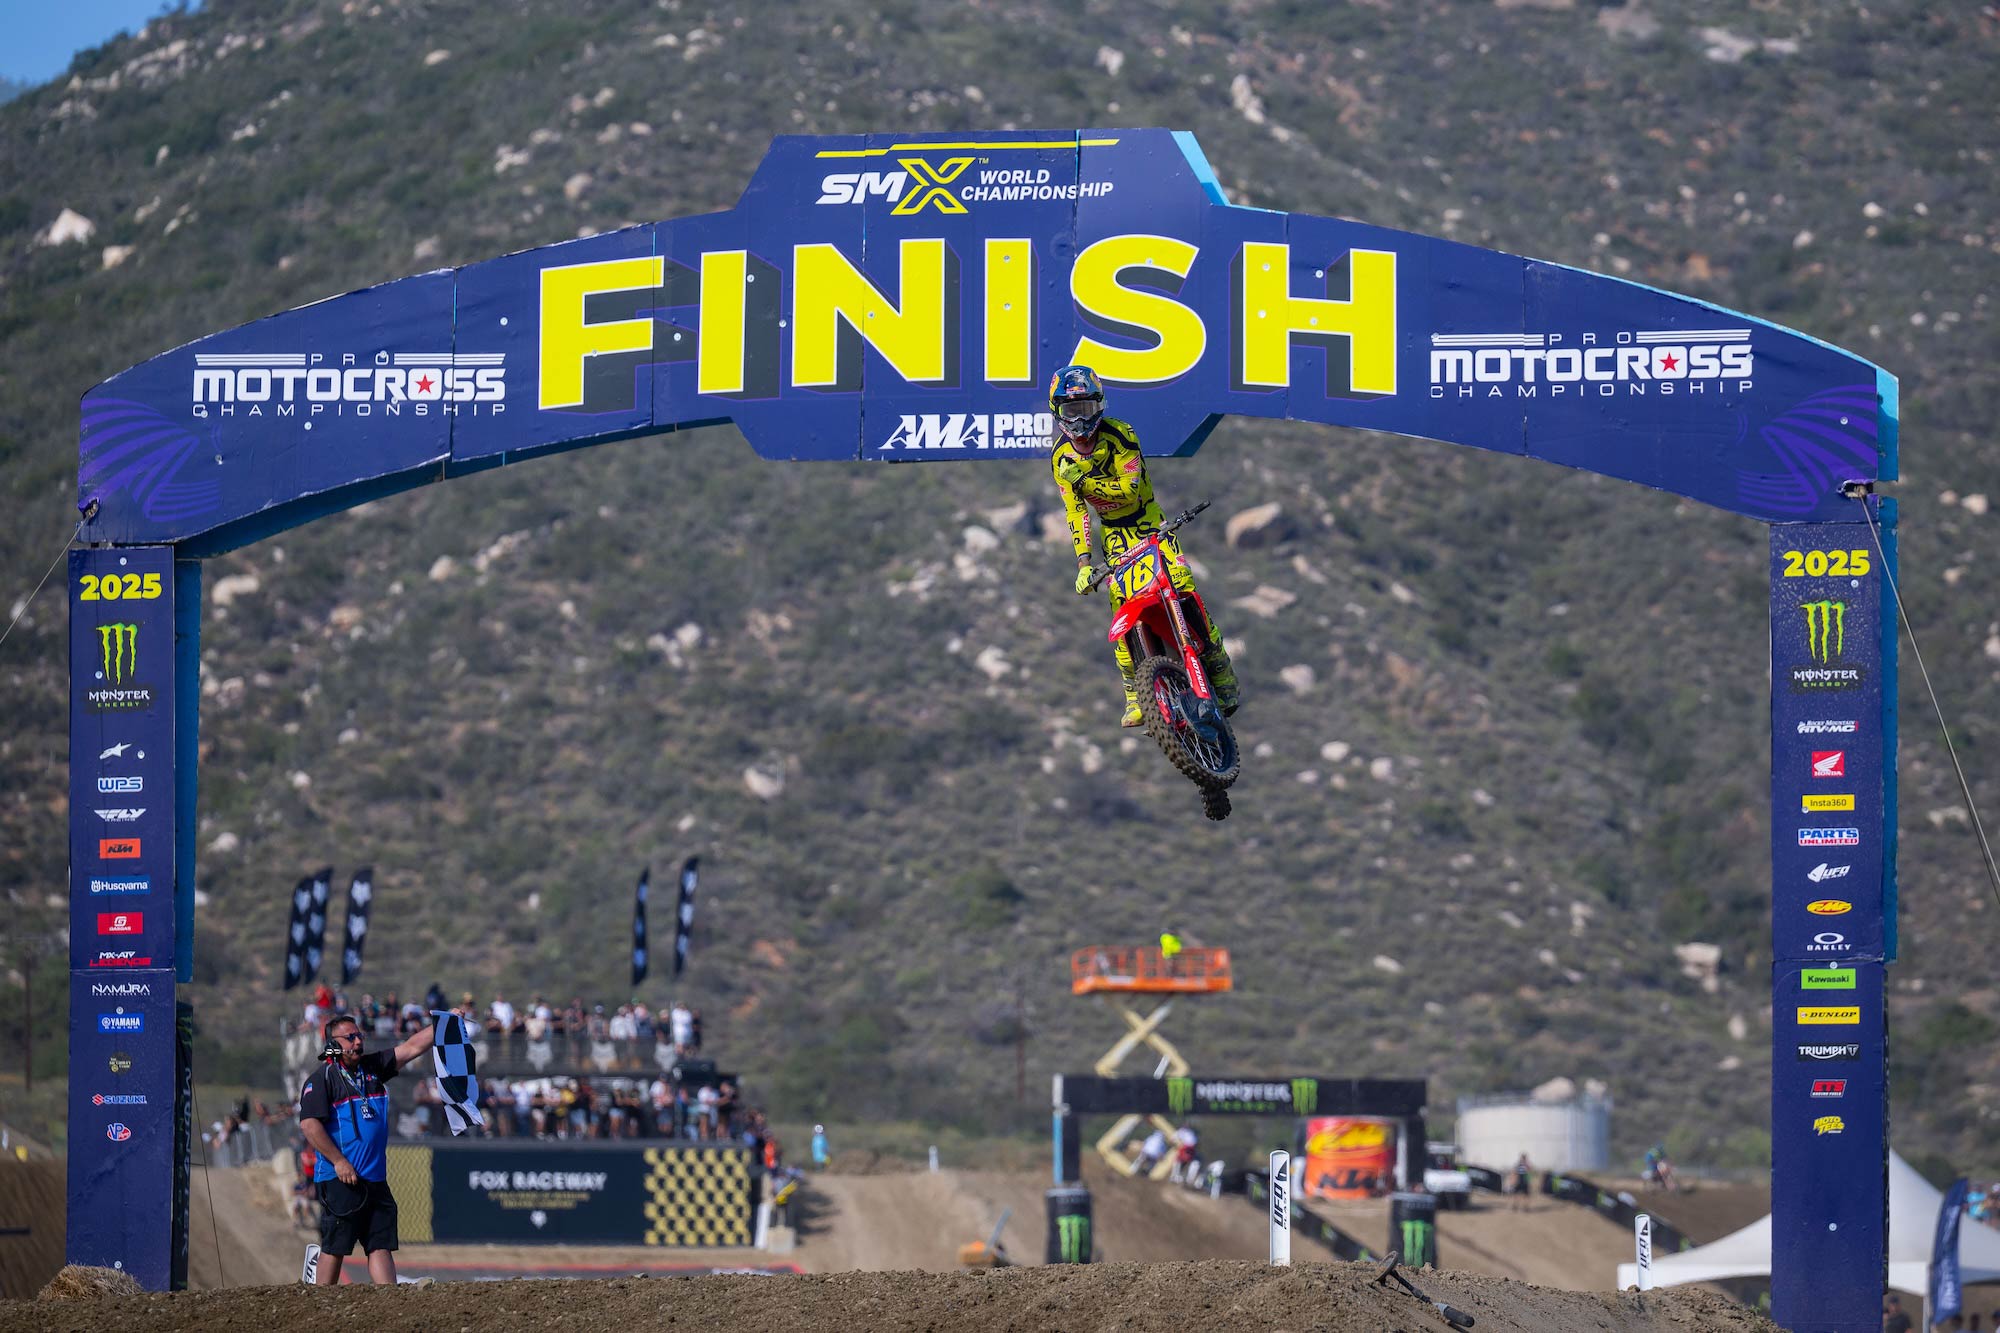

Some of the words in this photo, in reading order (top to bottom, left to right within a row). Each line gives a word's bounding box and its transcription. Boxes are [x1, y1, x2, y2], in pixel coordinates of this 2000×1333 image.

[980, 169, 1050, 184] WORLD
[815, 157, 976, 215] SMX
[961, 182, 1114, 201] CHAMPIONSHIP
[537, 233, 1397, 411] FINISH
[1549, 331, 1632, 345] PRO
[310, 354, 389, 365] PRO
[1430, 345, 1753, 383] MOTOCROSS
[193, 367, 507, 402] MOTOCROSS
[1430, 380, 1753, 398] CHAMPIONSHIP
[193, 403, 506, 417] CHAMPIONSHIP
[878, 413, 989, 449] AMA
[994, 412, 1053, 436] PRO
[994, 437, 1053, 448] RACING
[1083, 513, 1091, 548] ONDA
[1783, 550, 1870, 577] 2025
[1123, 554, 1155, 600] 18
[79, 573, 162, 600] 2025
[1191, 656, 1207, 693] DUNLOP
[1794, 669, 1858, 680] MONSTER
[89, 689, 150, 702] MONSTER
[97, 776, 143, 793] WPS
[1810, 799, 1846, 807] Insta360
[105, 808, 147, 819] FLY
[1799, 829, 1857, 838] PARTS
[107, 844, 133, 853] KTM
[101, 881, 148, 892] Husqvarna
[1808, 975, 1849, 983] Kawasaki
[92, 982, 150, 993] NAMURA
[110, 1017, 140, 1026] YAMAHA
[1798, 1046, 1847, 1057] TRIUMPH
[104, 1095, 147, 1104] SUZUKI
[469, 1171, 509, 1190] FOX
[512, 1171, 607, 1191] RACEWAY
[1274, 1182, 1283, 1227] UFO
